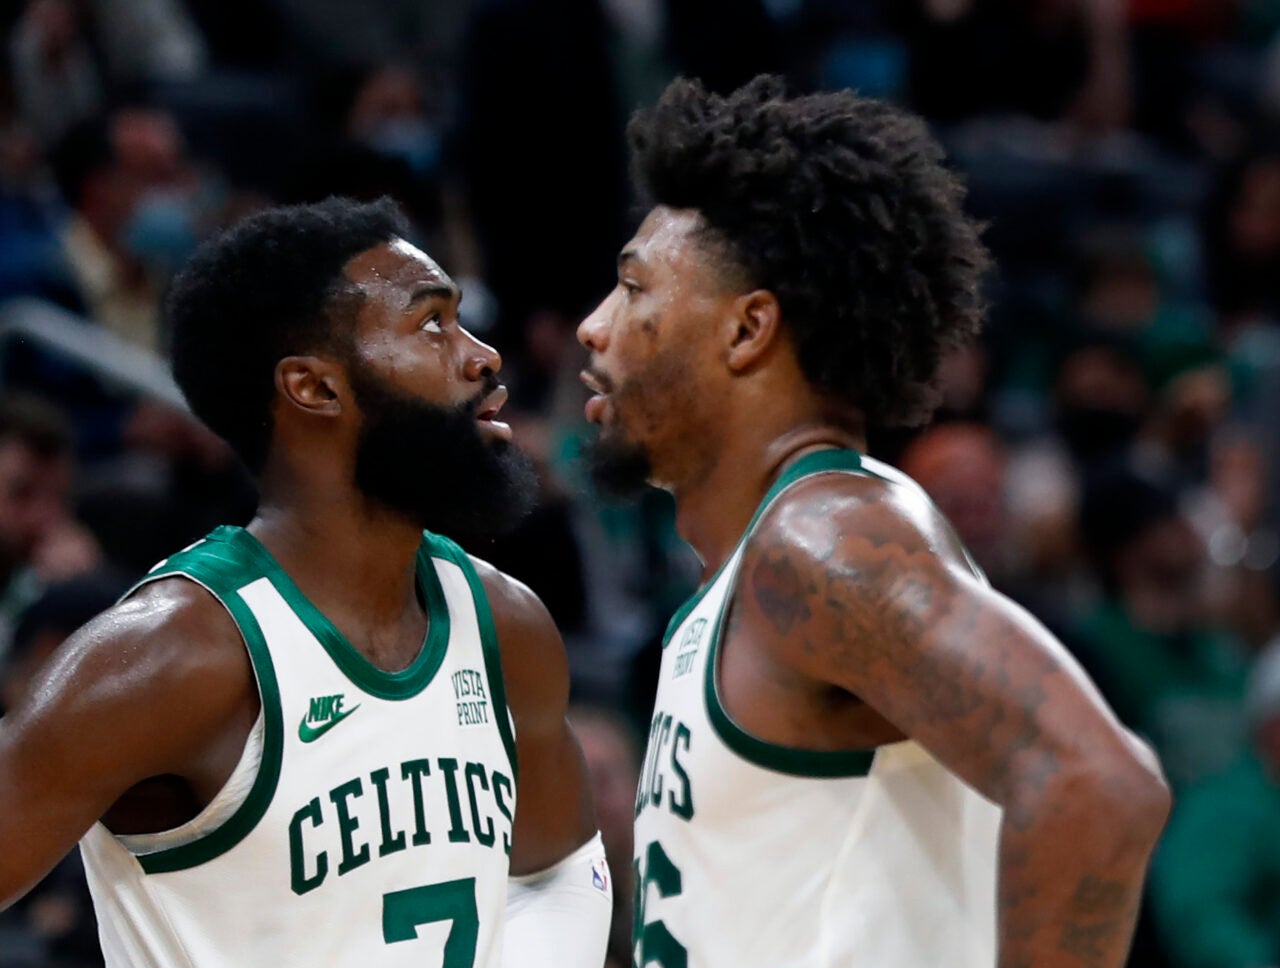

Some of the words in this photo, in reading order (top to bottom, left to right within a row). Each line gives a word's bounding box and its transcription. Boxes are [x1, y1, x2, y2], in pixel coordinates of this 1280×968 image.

[451, 669, 487, 700] VISTA
[307, 693, 345, 723] NIKE
[456, 700, 489, 726] PRINT
[289, 757, 513, 895] CELTICS
